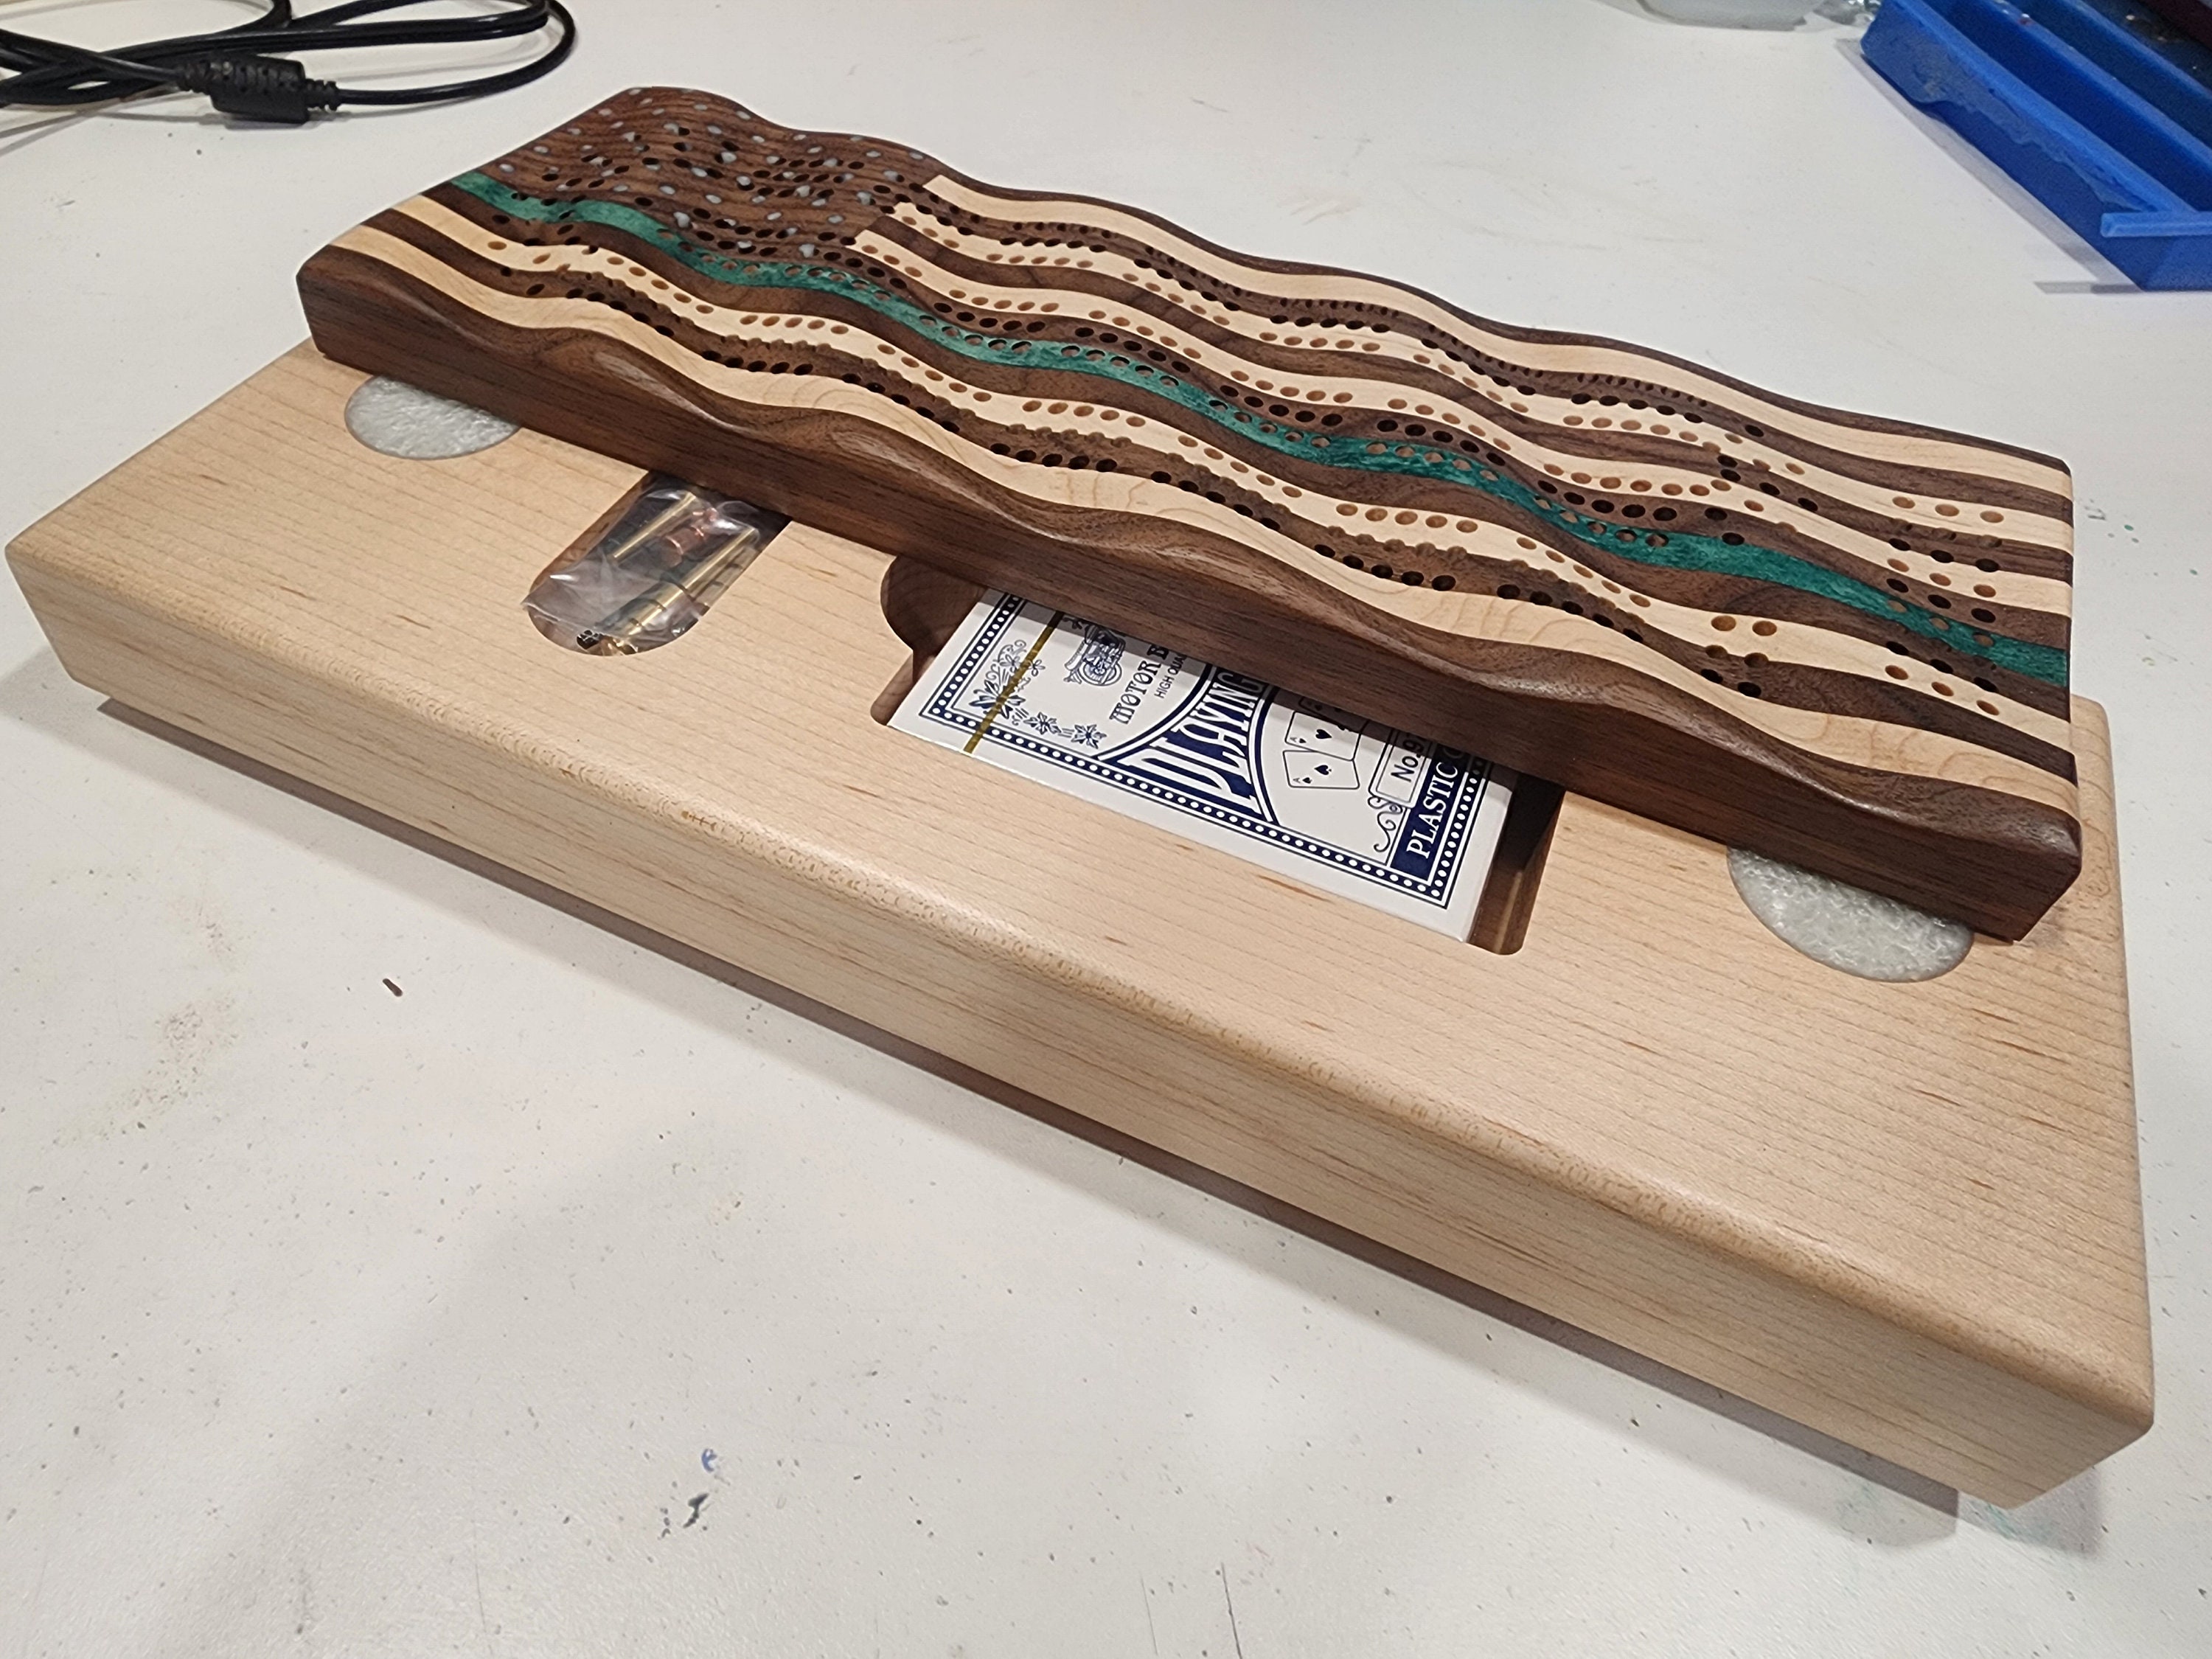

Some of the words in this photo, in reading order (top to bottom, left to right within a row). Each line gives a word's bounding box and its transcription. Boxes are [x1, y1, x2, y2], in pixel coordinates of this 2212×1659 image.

[1109, 661, 1161, 724] MOTOR
[1154, 675, 1175, 698] HIGH
[1117, 671, 1264, 815] PLAYING
[1391, 734, 1424, 782] No.9
[1406, 762, 1458, 859] PLASTIC
